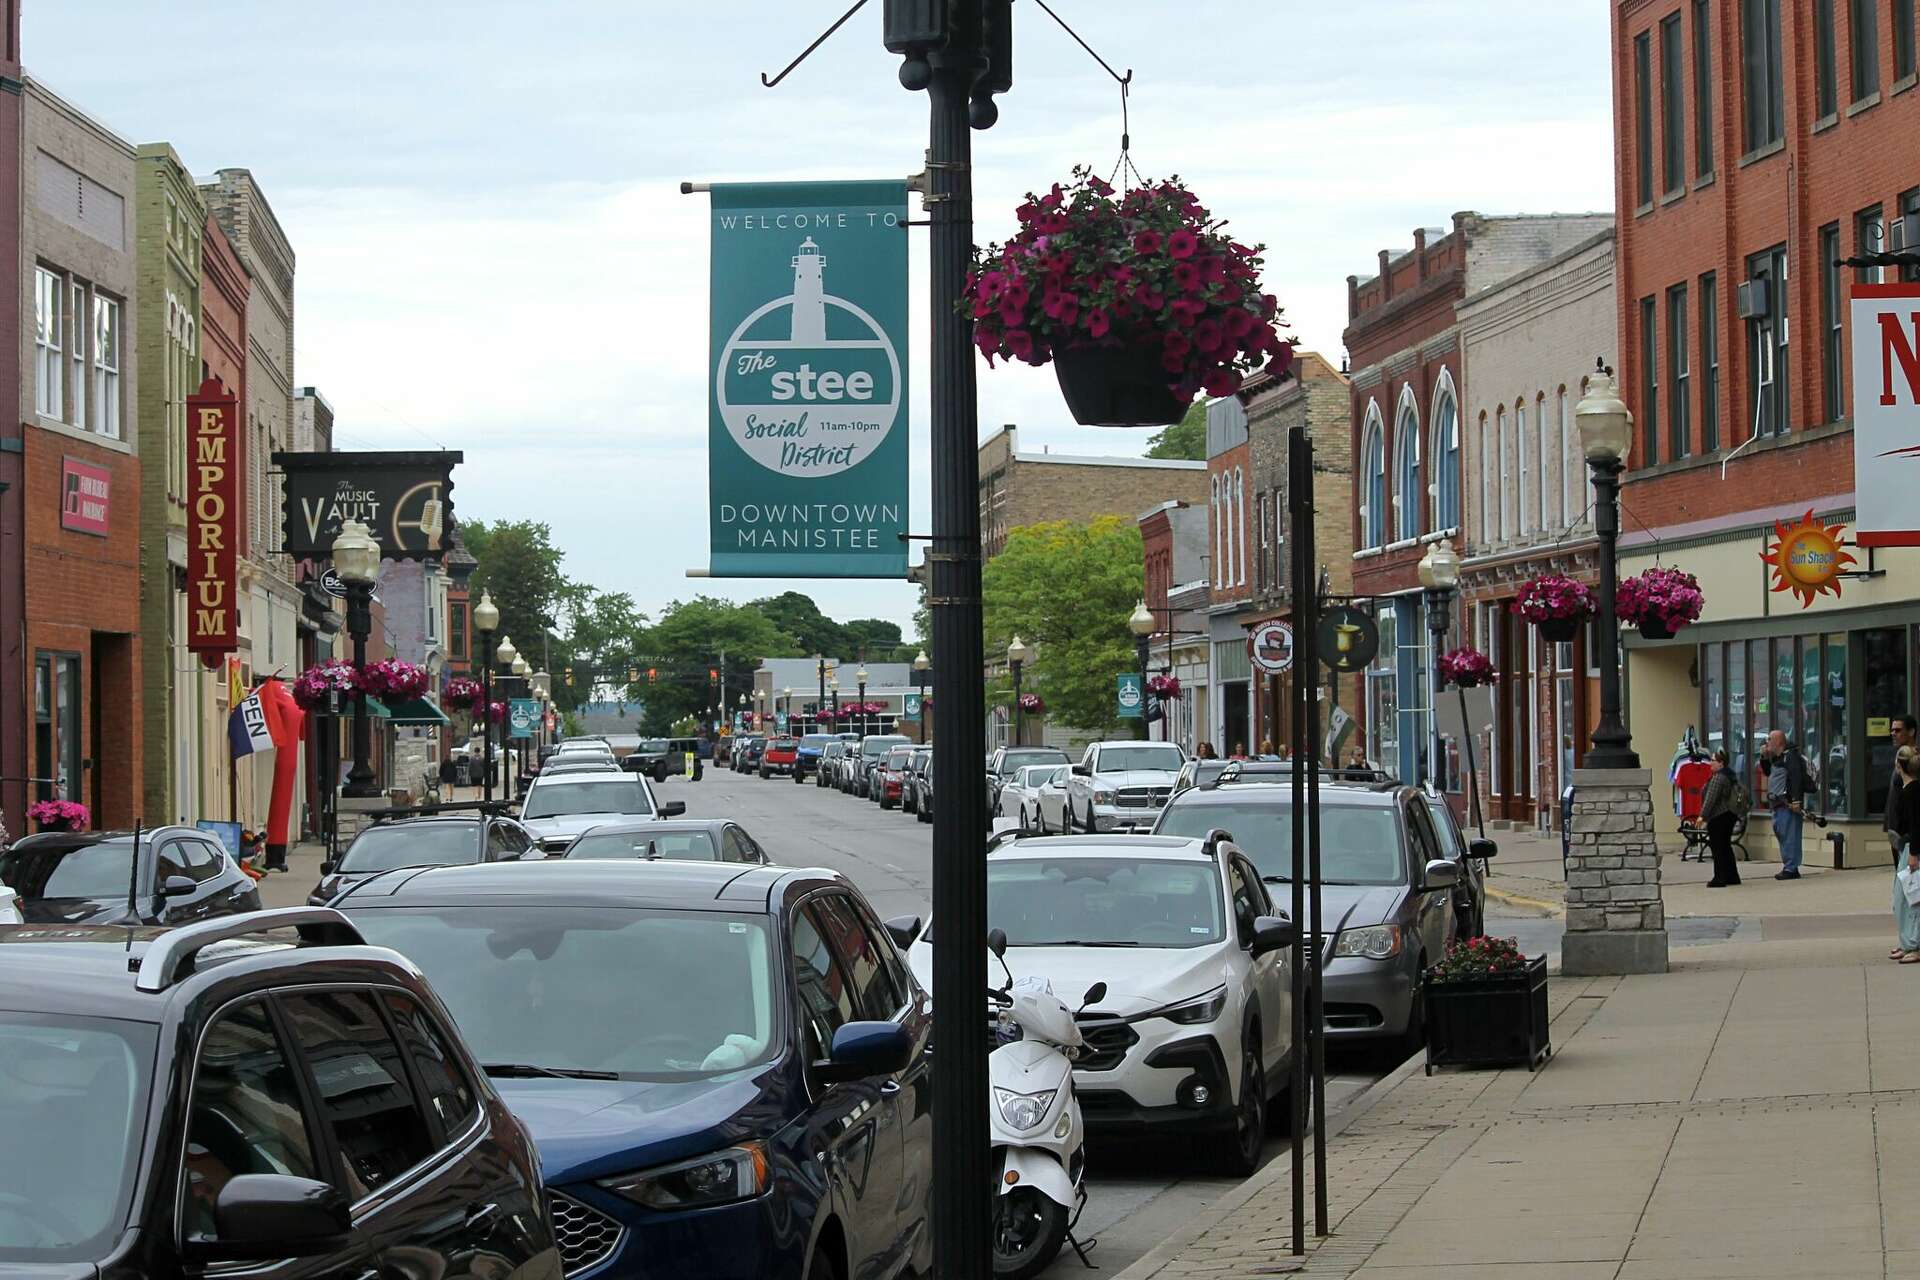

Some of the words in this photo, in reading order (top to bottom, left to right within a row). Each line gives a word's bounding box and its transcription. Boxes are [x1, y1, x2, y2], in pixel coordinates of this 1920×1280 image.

[720, 213, 848, 230] WELCOME
[867, 212, 898, 228] TO
[737, 351, 776, 376] The
[771, 364, 874, 400] stee
[744, 412, 808, 439] Social
[820, 421, 880, 432] 11am-10pm
[780, 441, 858, 470] District
[335, 491, 375, 502] MUSIC
[196, 408, 227, 636] EMPORIUM
[720, 504, 899, 524] DOWNTOWN
[738, 528, 879, 548] MANISTEE
[244, 697, 267, 738] PEN
